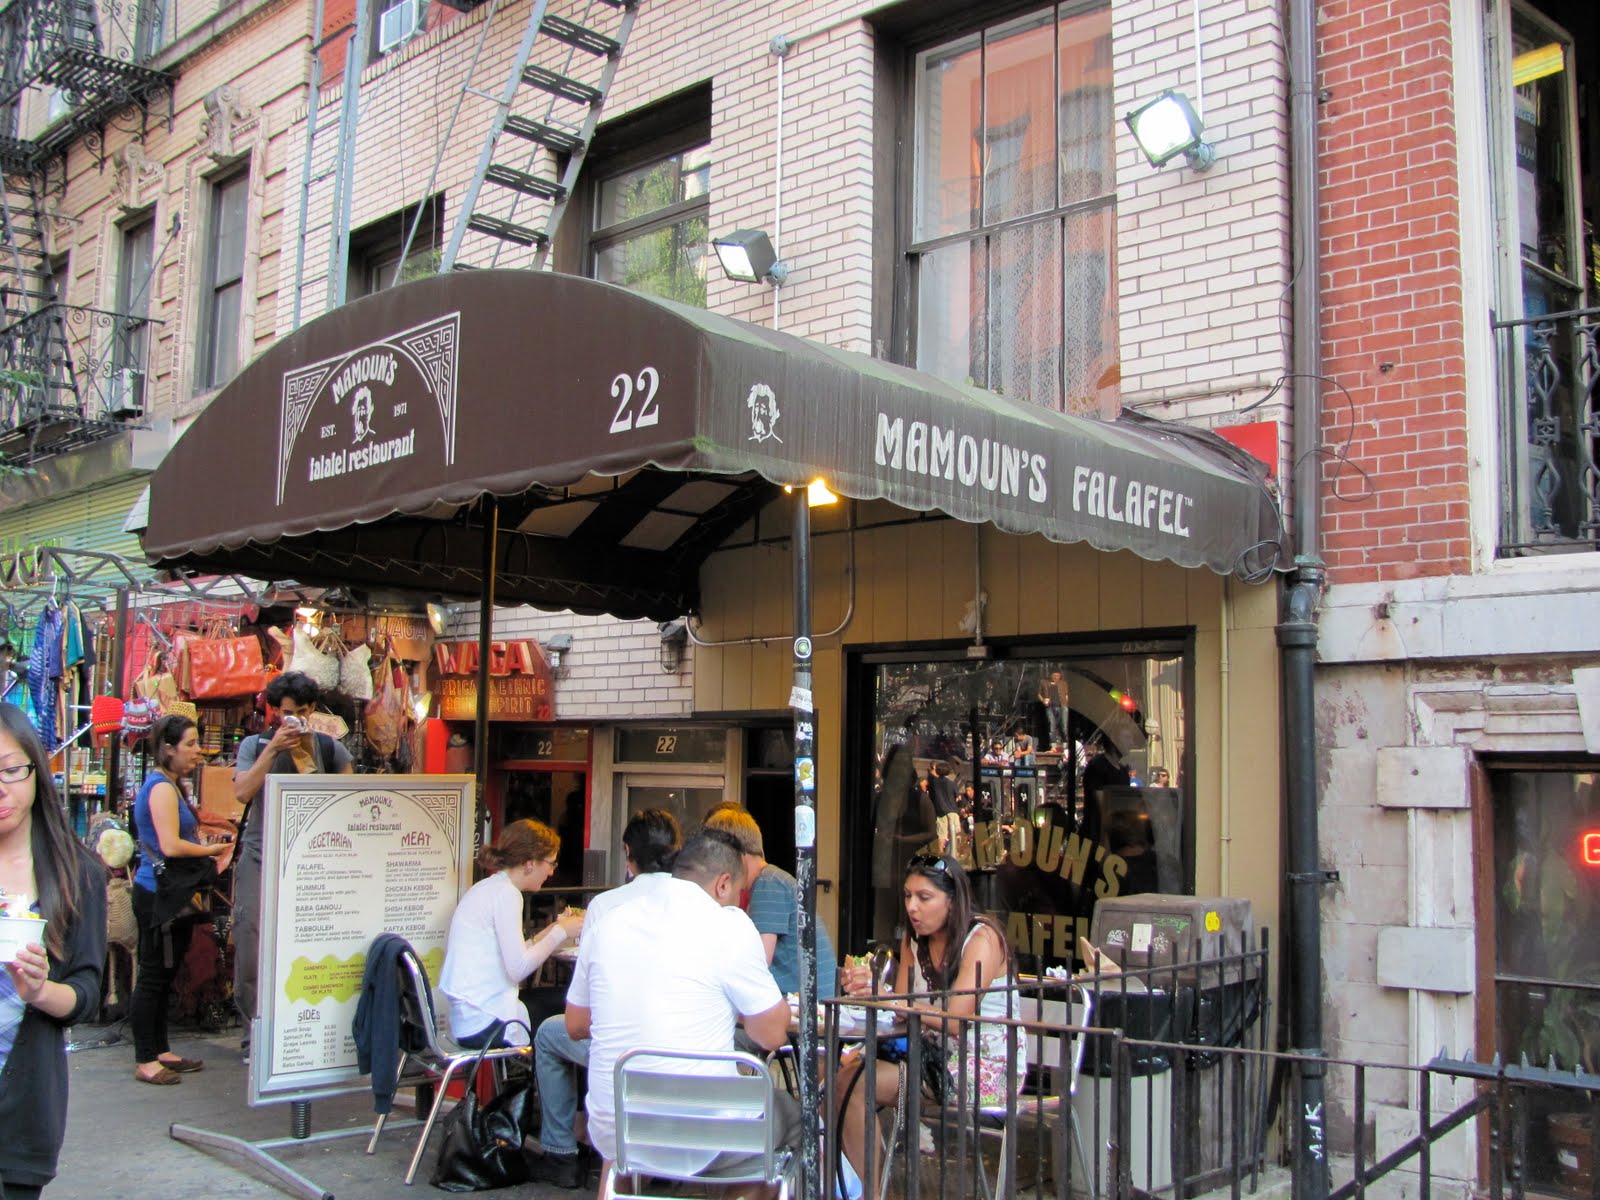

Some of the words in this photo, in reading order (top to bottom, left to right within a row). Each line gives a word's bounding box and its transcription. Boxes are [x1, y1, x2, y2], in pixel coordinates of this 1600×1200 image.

[331, 352, 398, 404] MAMOUN'S
[609, 366, 660, 434] 22
[393, 402, 408, 418] 1971
[320, 424, 337, 439] EST.
[309, 446, 346, 482] falafel
[348, 428, 415, 473] restaurant
[874, 412, 1047, 503] MAMOUN'S
[1072, 466, 1190, 538] FALAFEL
[377, 617, 427, 641] WAGA
[434, 680, 483, 696] AFRICA
[499, 679, 546, 695] ETHNIC
[538, 741, 552, 755] 22
[657, 737, 675, 751] 22
[359, 795, 393, 808] MAMOUN'S
[308, 831, 353, 850] VEGETARIAN
[401, 831, 432, 847] MEAT
[915, 816, 1128, 898] MOUN'S
[297, 1009, 321, 1022] SIDES
